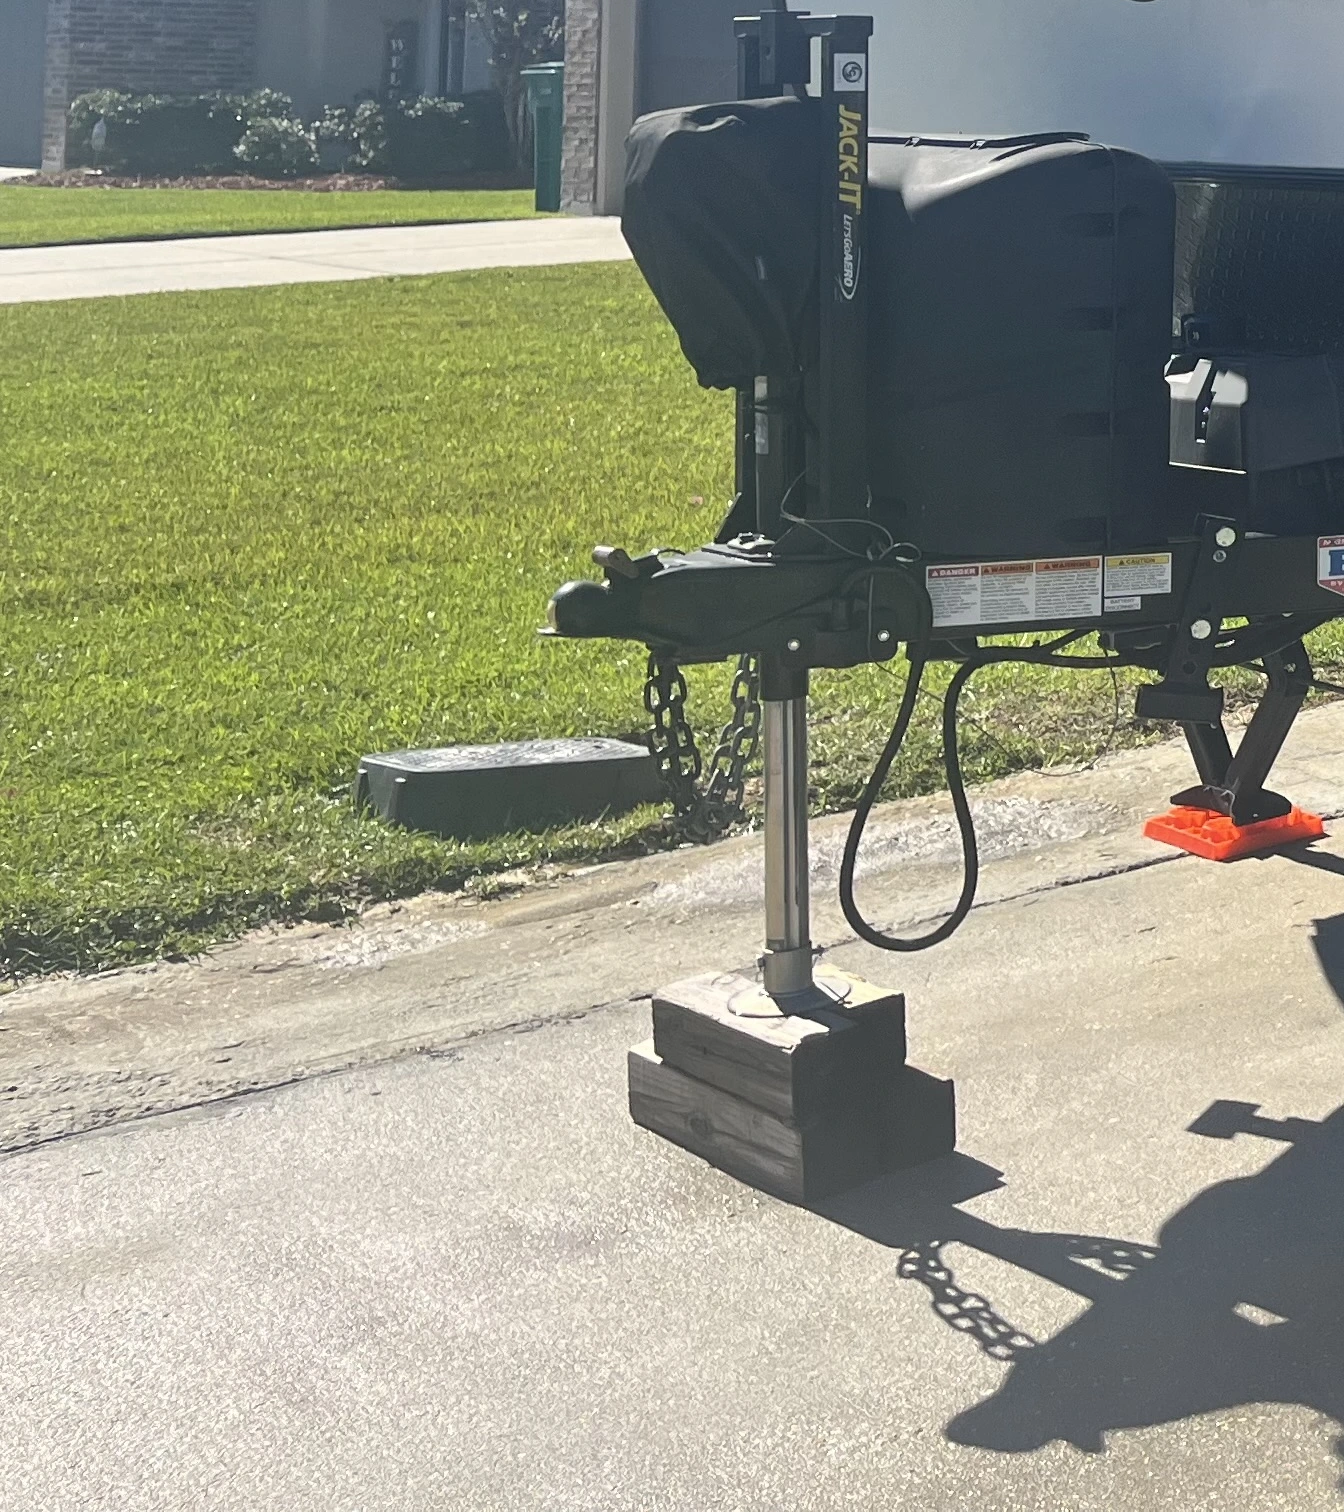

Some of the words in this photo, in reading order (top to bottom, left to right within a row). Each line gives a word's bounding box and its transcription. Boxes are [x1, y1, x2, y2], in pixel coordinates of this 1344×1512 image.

[838, 103, 862, 212] JACK-IT
[1051, 560, 1091, 569] WARNING
[1126, 557, 1156, 565] CAUTION
[939, 568, 976, 577] DANGER
[990, 564, 1032, 574] WARNING
